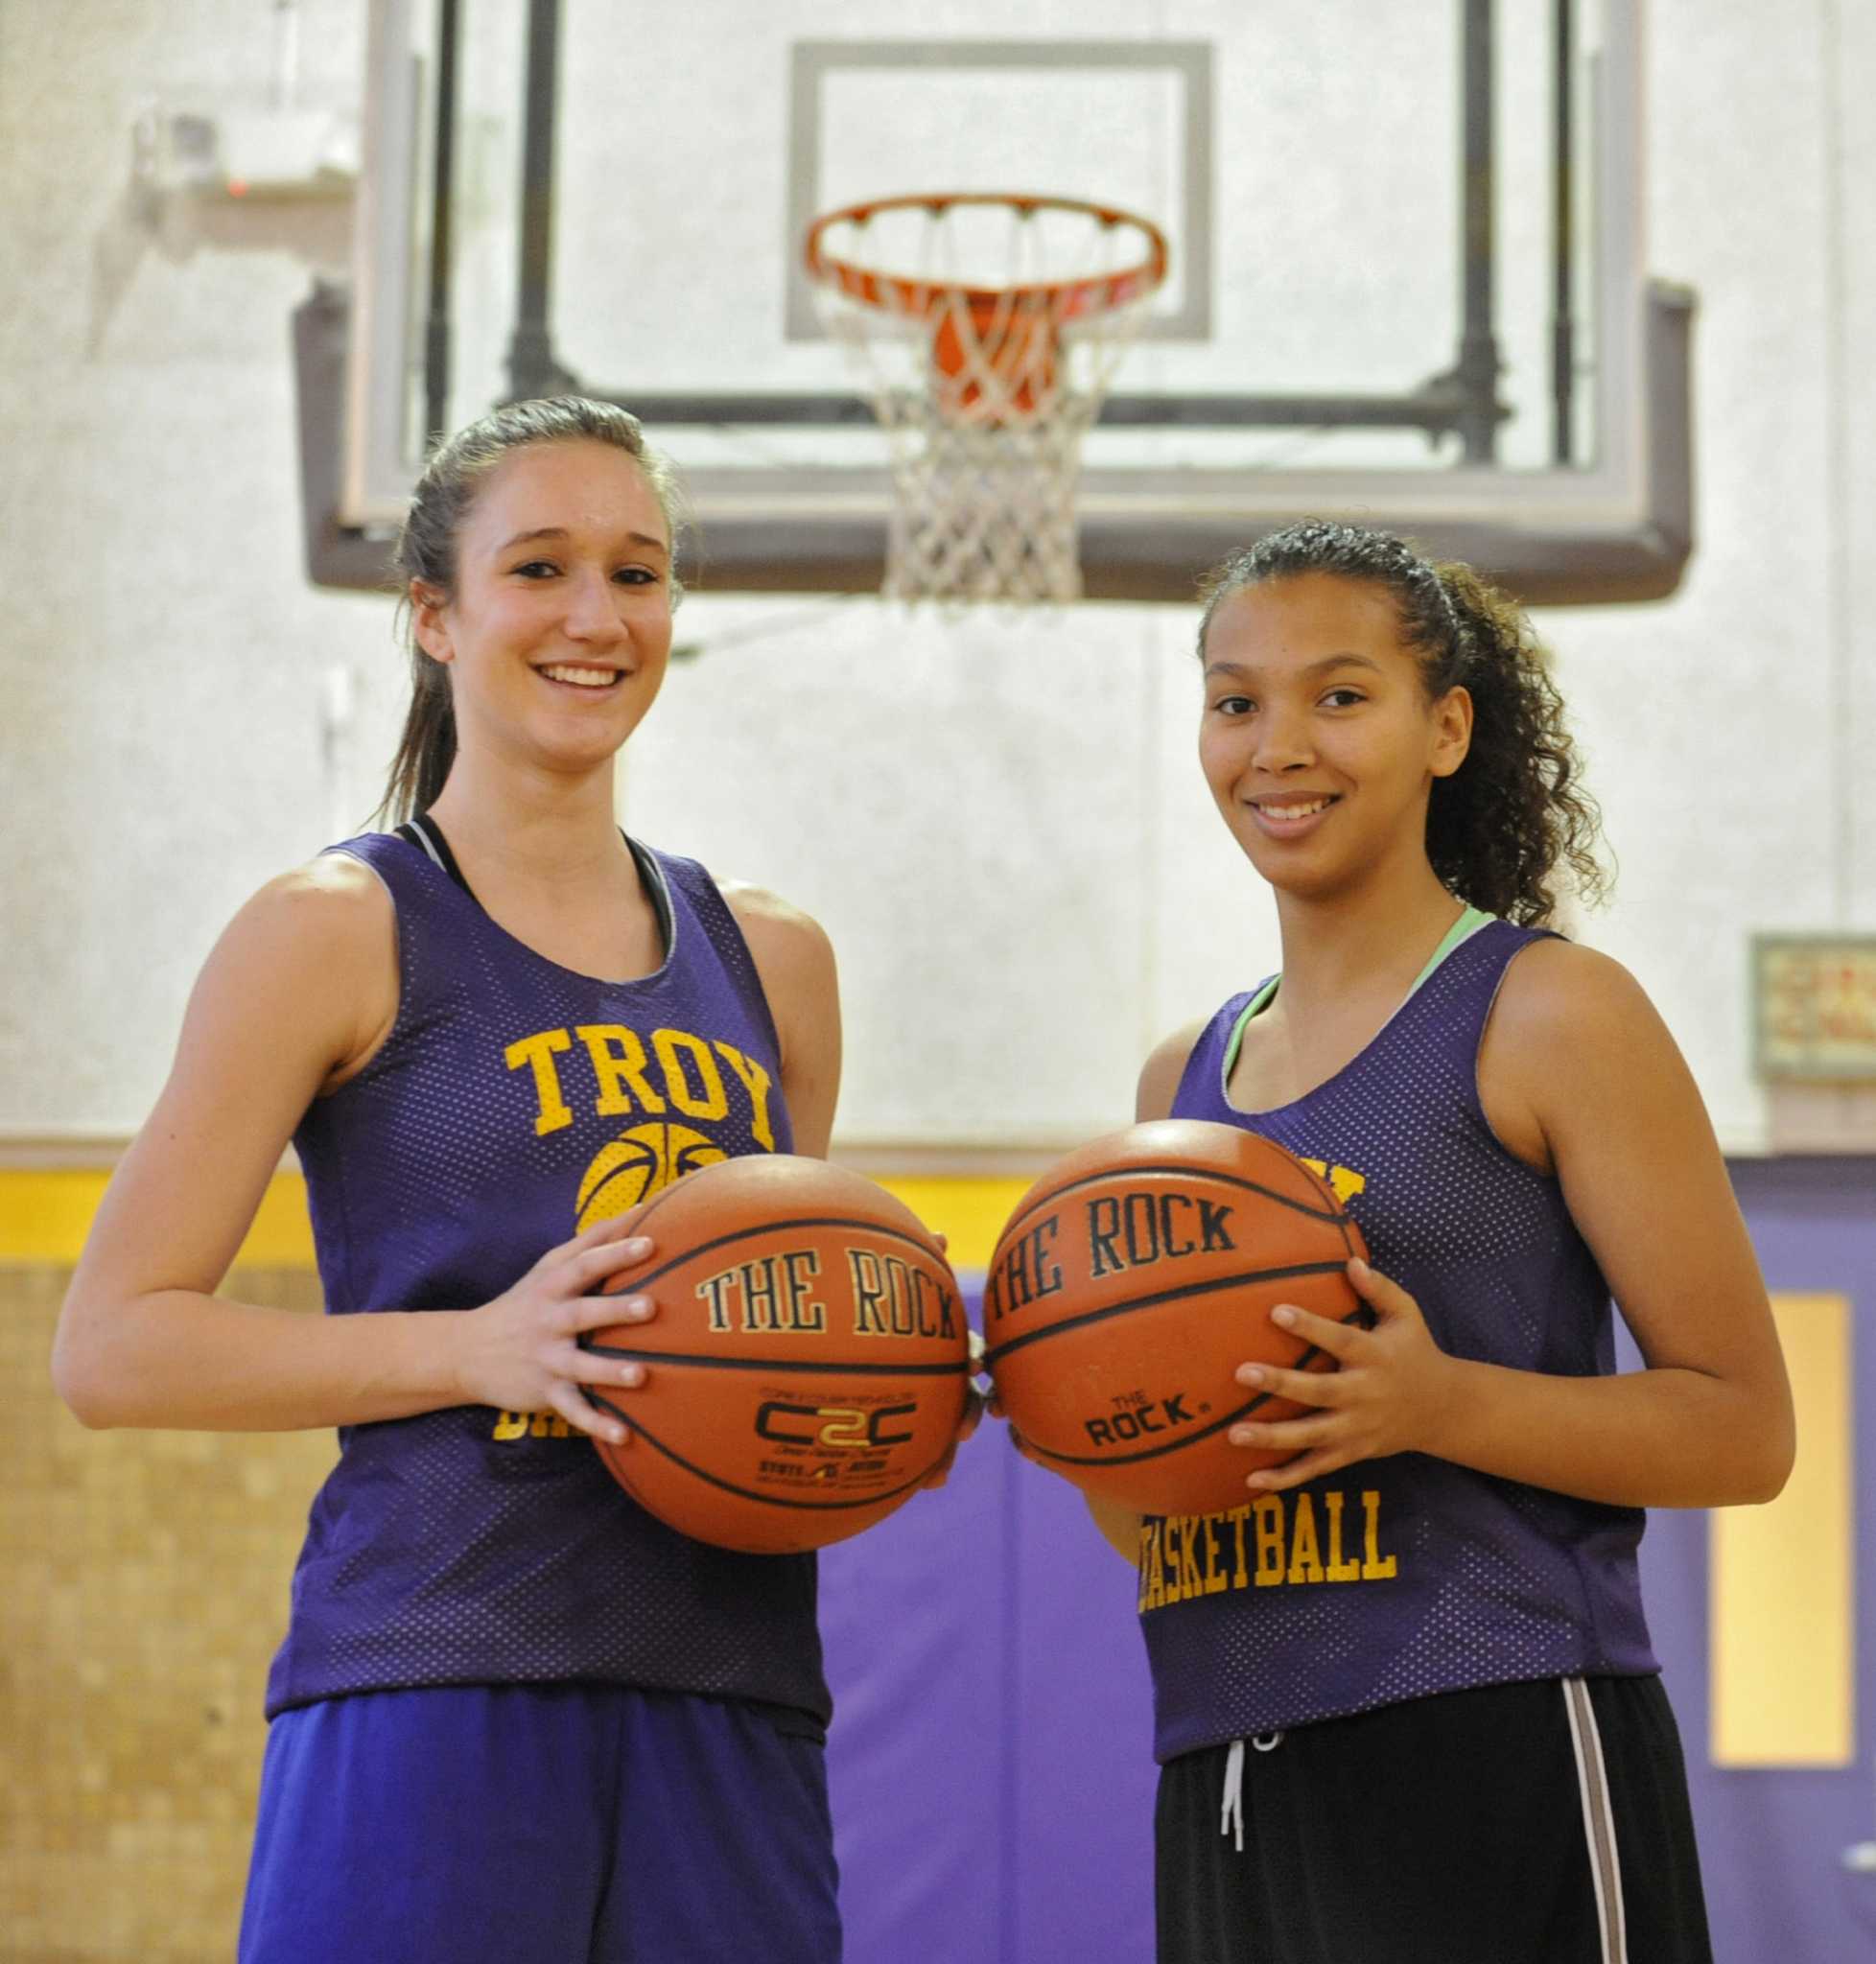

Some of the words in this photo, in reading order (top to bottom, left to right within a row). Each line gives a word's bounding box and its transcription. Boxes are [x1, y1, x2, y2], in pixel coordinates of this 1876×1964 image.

[504, 1023, 775, 1153] TROY
[695, 1247, 827, 1335] THE
[845, 1247, 957, 1341] ROCK
[991, 1213, 1063, 1321] THE
[1086, 1192, 1236, 1280] ROCK
[755, 1401, 917, 1447] C2C
[1111, 1390, 1147, 1411] THE
